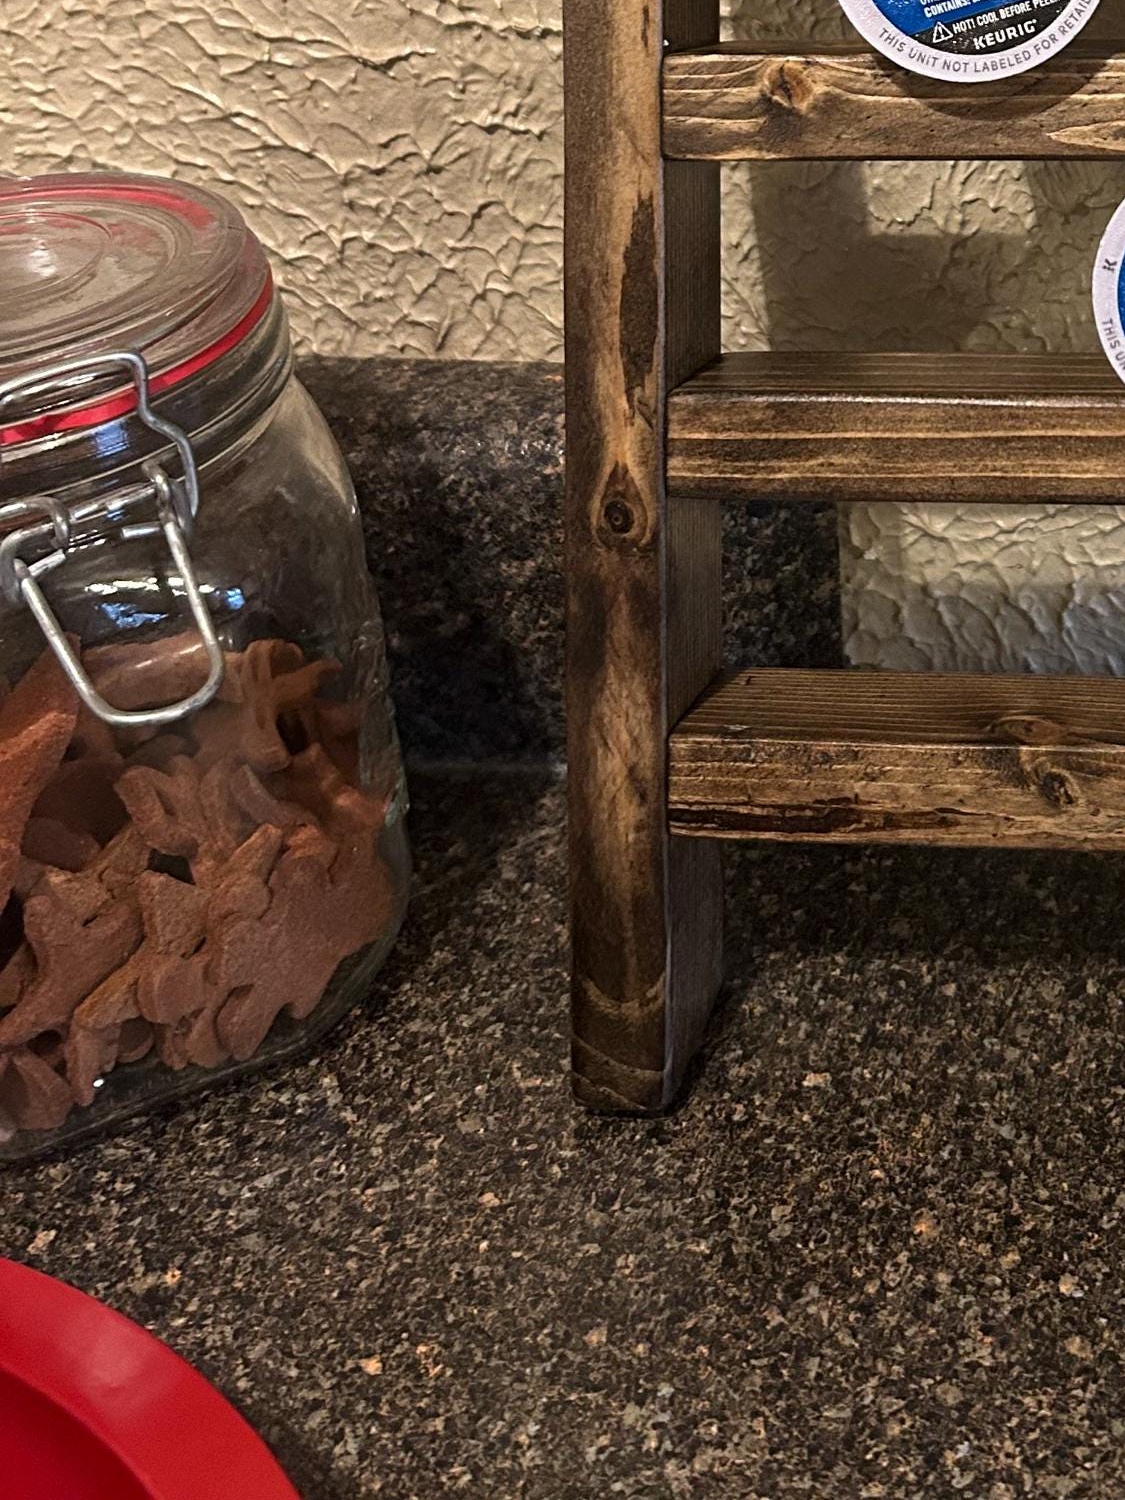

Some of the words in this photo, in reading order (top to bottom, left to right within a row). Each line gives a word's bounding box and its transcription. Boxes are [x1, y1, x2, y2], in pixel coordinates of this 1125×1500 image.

[951, 18, 976, 34] HOT!
[974, 12, 998, 27] COOL
[998, 0, 1033, 20] BEFORE
[878, 26, 907, 52] THIS
[907, 47, 938, 68] UNIT
[942, 60, 968, 74] NOT
[973, 49, 1031, 72] LABELED
[1033, 32, 1059, 57] FOR
[1101, 317, 1121, 349] THIS
